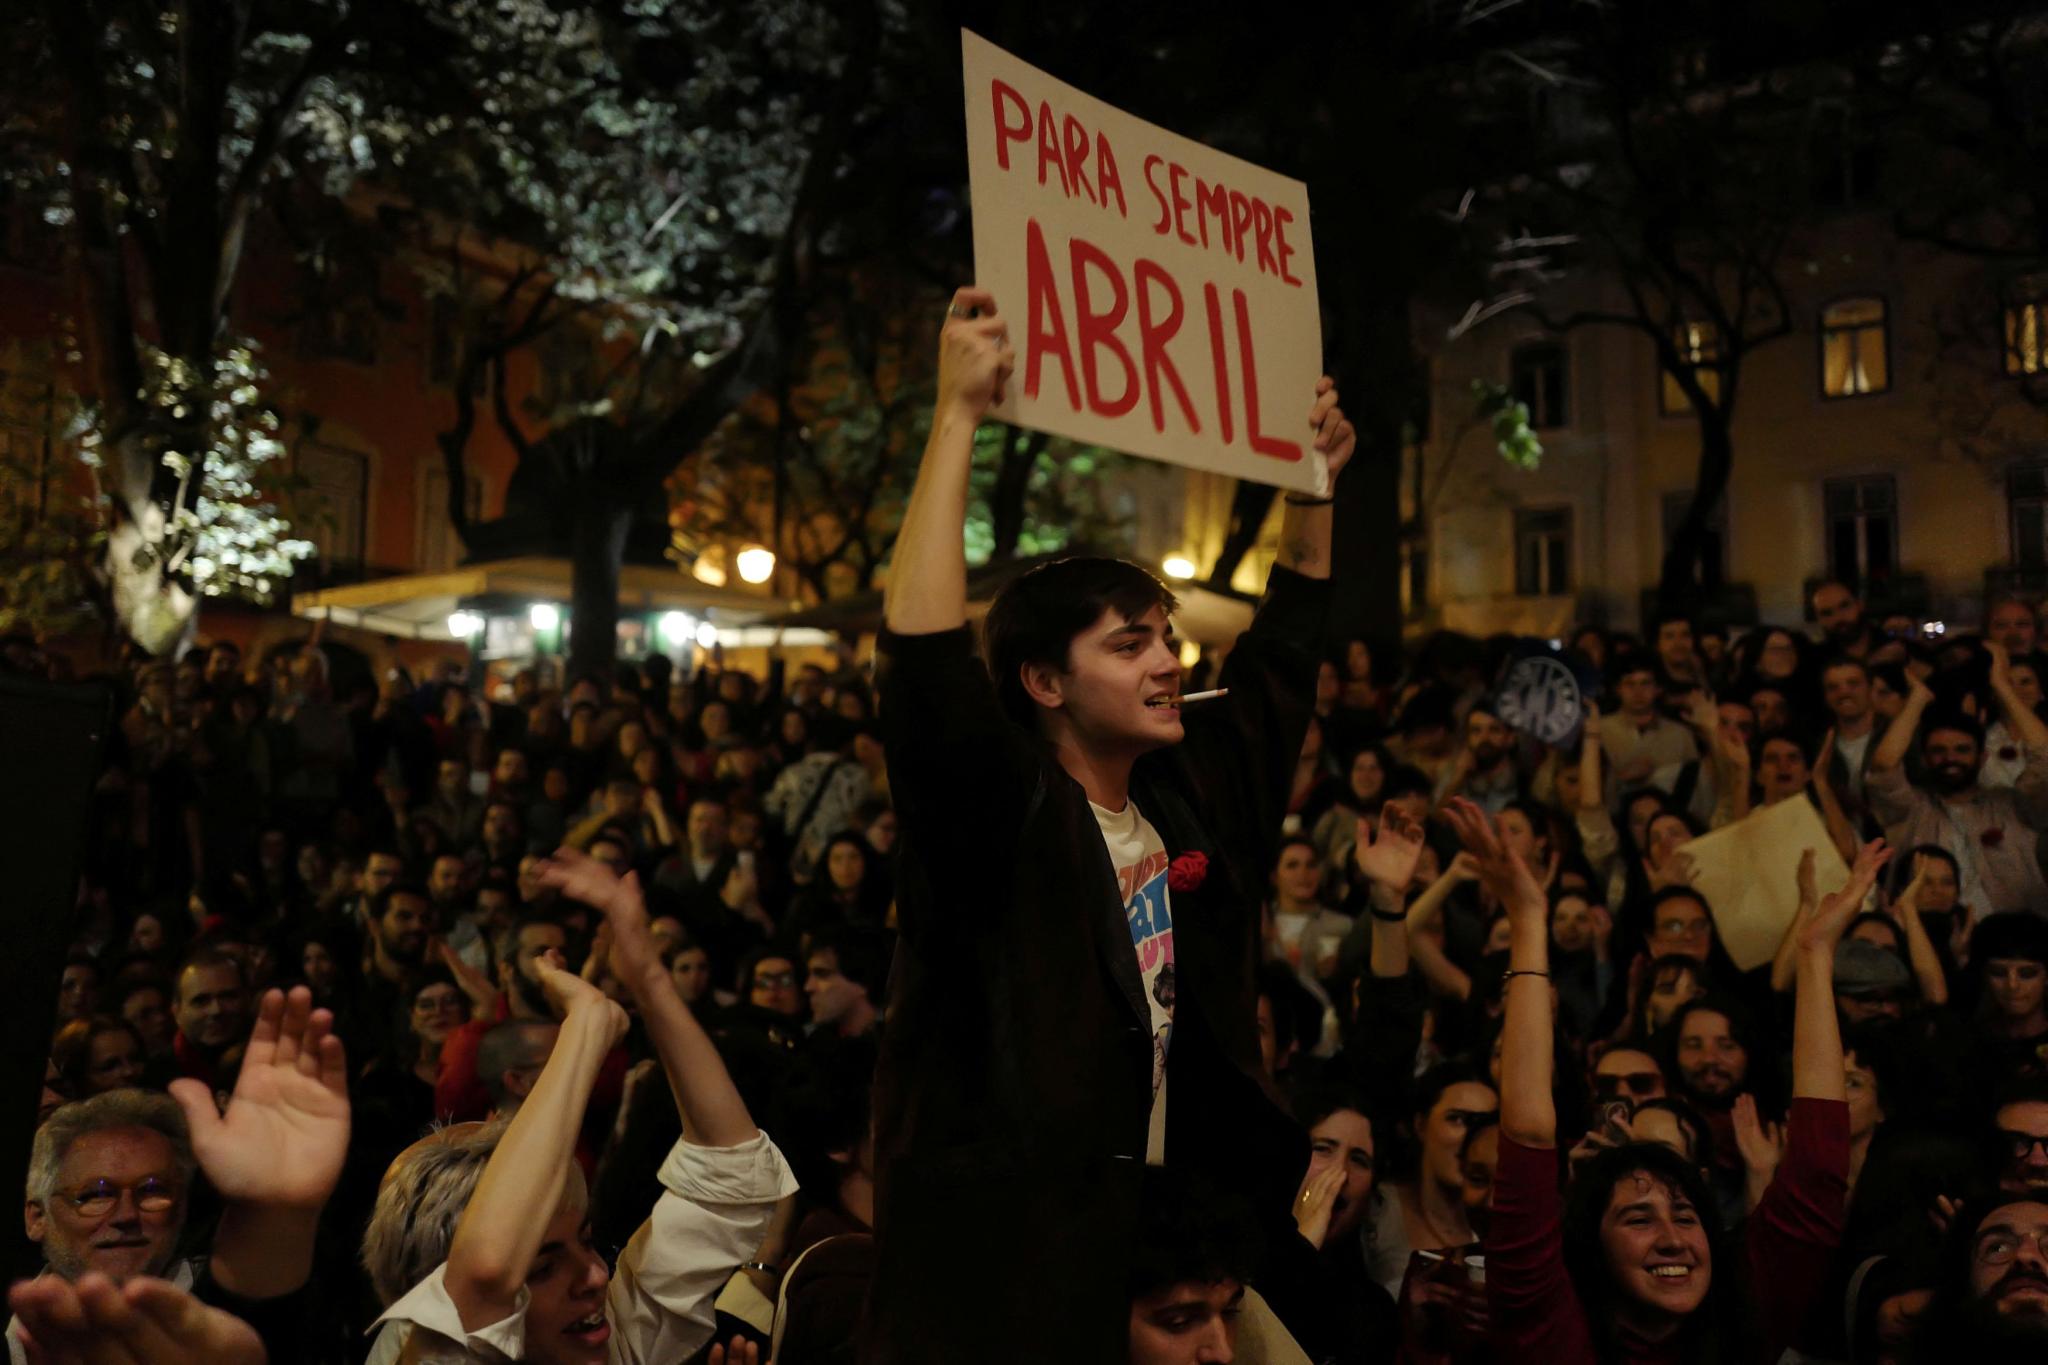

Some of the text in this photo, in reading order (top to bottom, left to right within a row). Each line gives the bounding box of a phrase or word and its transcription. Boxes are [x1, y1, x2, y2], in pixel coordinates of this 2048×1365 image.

[992, 78, 1303, 288] PARA SEMPRE
[1024, 216, 1304, 462] ABRIL
